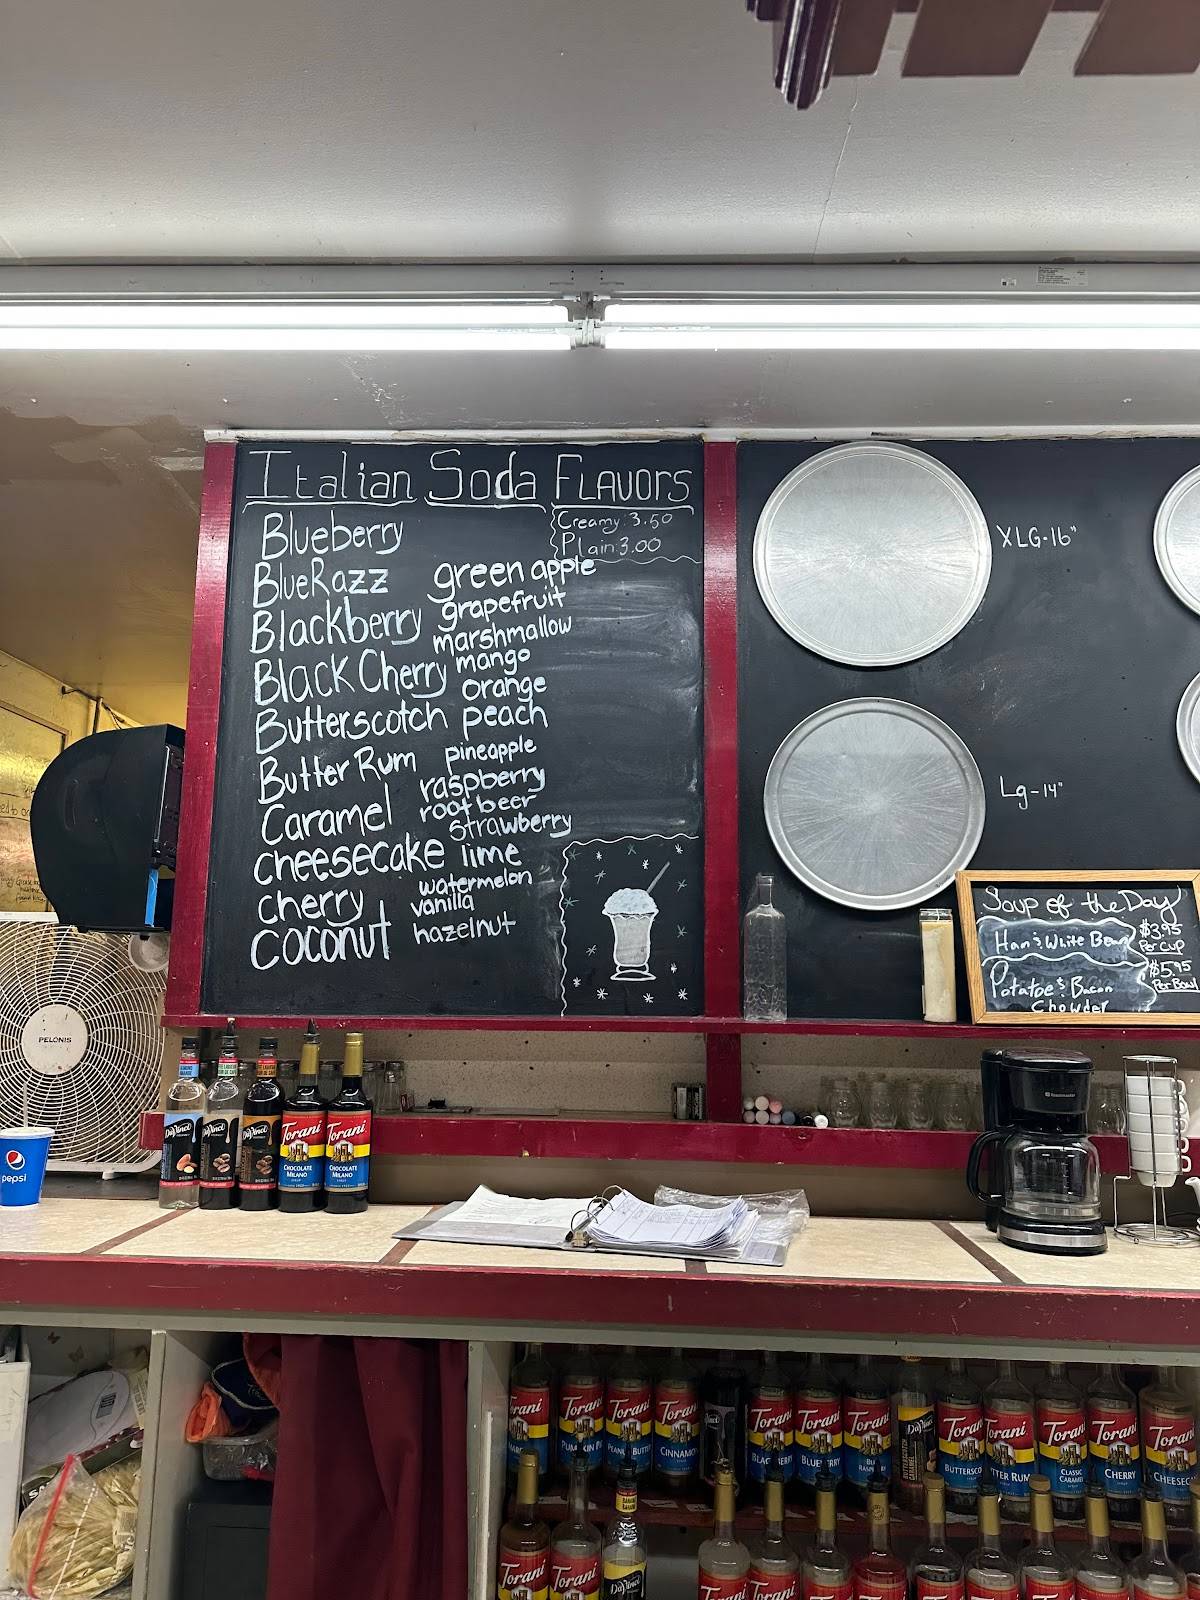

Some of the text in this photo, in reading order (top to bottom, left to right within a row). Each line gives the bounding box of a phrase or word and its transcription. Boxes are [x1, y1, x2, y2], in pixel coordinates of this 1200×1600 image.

[246, 450, 413, 499] Italian
[429, 449, 537, 501] Soda
[261, 510, 403, 560] Blueberry
[629, 512, 673, 529] 3.50
[619, 537, 661, 555] 3.00
[427, 555, 597, 604] green apple
[438, 585, 566, 632] grapefruit
[249, 596, 422, 654] Blackberry
[433, 615, 572, 656] marshmallow
[456, 648, 531, 675] mango
[253, 648, 447, 706] Black Cherry
[462, 675, 547, 702] orange
[255, 699, 448, 754] Butterscotch
[462, 704, 548, 741] peach
[445, 734, 537, 774] pineapple
[258, 745, 417, 804] Butter Rum
[420, 766, 546, 803] raspberry
[261, 782, 393, 846] Caramel
[420, 794, 537, 823] root beer
[461, 842, 522, 869] lime
[419, 868, 532, 897] watermelon
[410, 892, 475, 918] vanilla
[983, 884, 1182, 926] Soup of the Day
[412, 911, 517, 944] hazelnut
[995, 929, 1030, 955] Ham
[1046, 933, 1084, 950] White
[1090, 930, 1130, 947] Bean
[1139, 918, 1183, 940] $3.95
[1138, 939, 1157, 953] Per
[989, 960, 1054, 999] Potatoe
[1071, 975, 1114, 999] Bacon
[1149, 958, 1193, 978] $5.95
[1152, 976, 1199, 993] Per Bowl
[1031, 998, 1110, 1014] Chowder
[38, 1036, 72, 1044] PELONIS
[281, 1119, 323, 1147] Torani
[326, 1119, 367, 1147] Torani
[1, 1173, 27, 1185] pepsi
[984, 1418, 1026, 1445] Torani
[561, 1440, 595, 1453] PUMKIN
[1105, 1468, 1137, 1480] CHERRY
[500, 1558, 547, 1589] Torani
[552, 1561, 598, 1592] Torani
